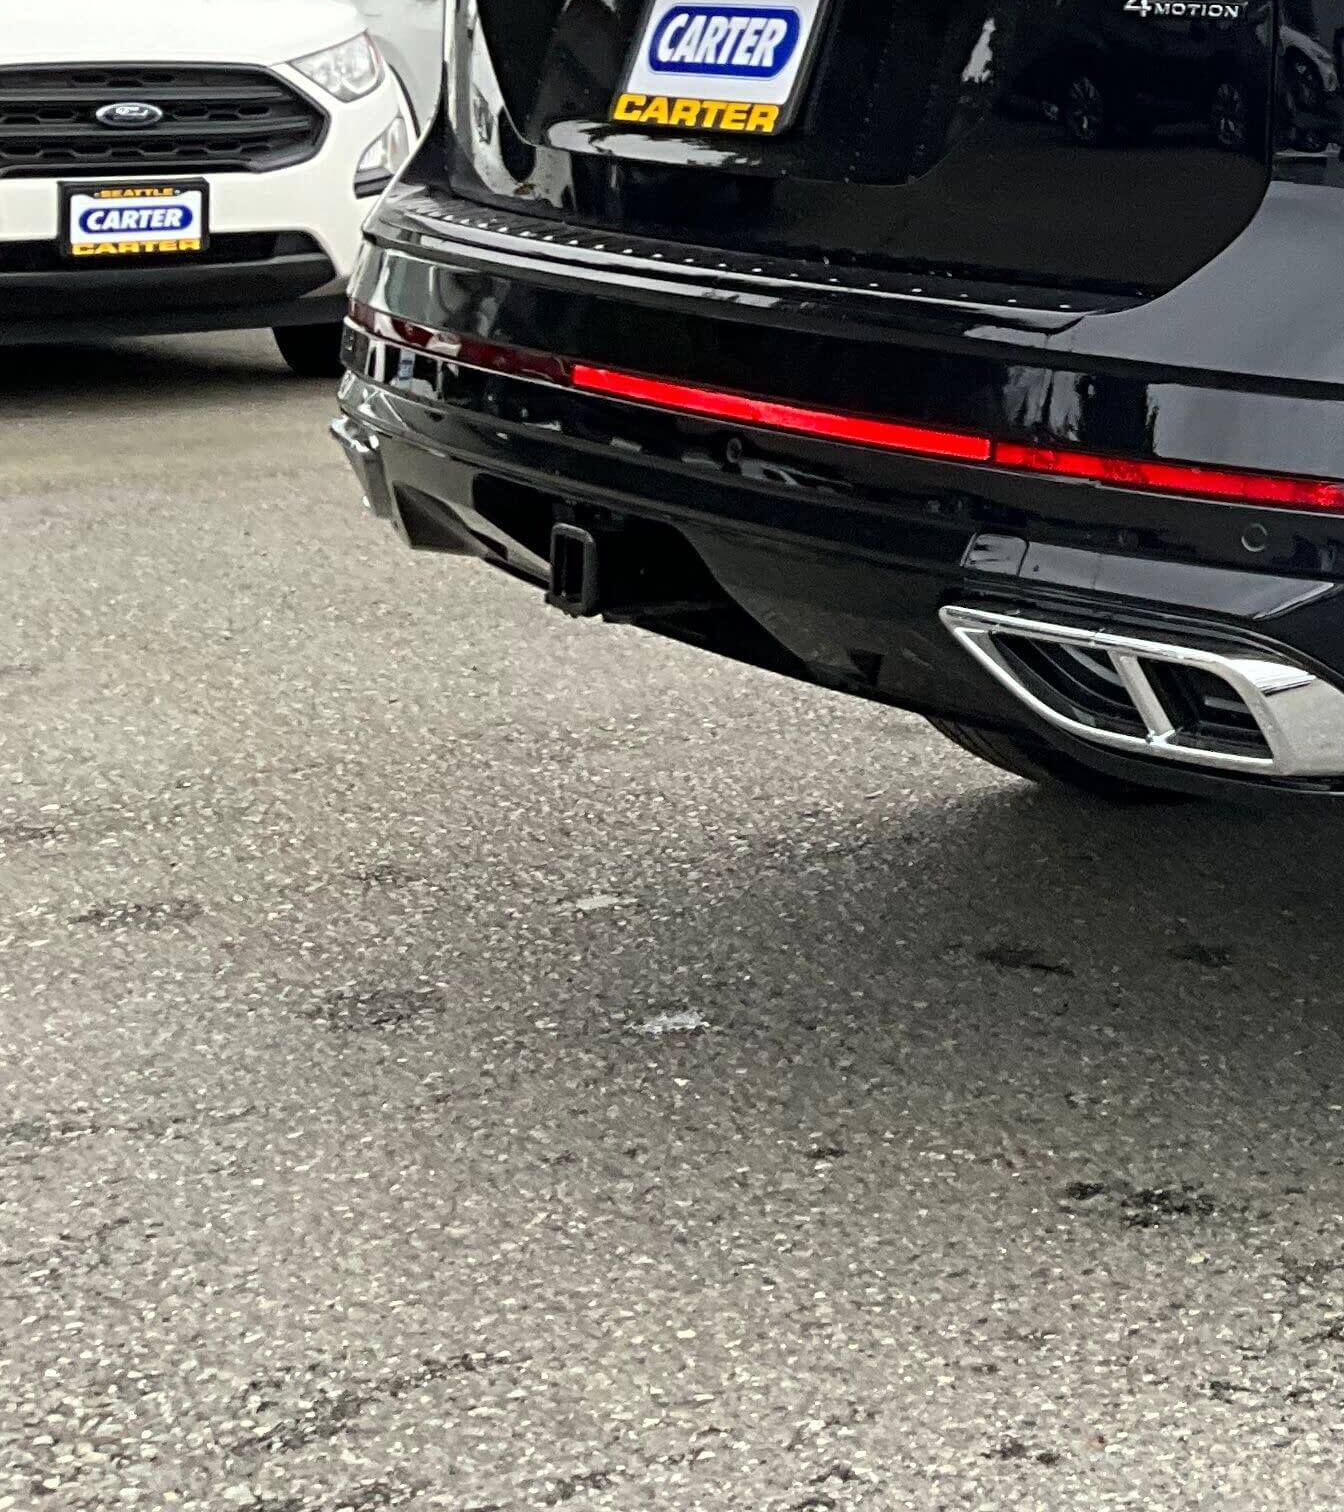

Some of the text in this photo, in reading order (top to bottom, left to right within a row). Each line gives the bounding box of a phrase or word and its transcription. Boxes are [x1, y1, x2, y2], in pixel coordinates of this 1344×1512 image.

[657, 13, 788, 68] CARTER
[613, 93, 780, 133] CARTER
[100, 188, 174, 198] SEATTLE
[86, 208, 183, 231] CARTER
[72, 239, 200, 256] CARTER
